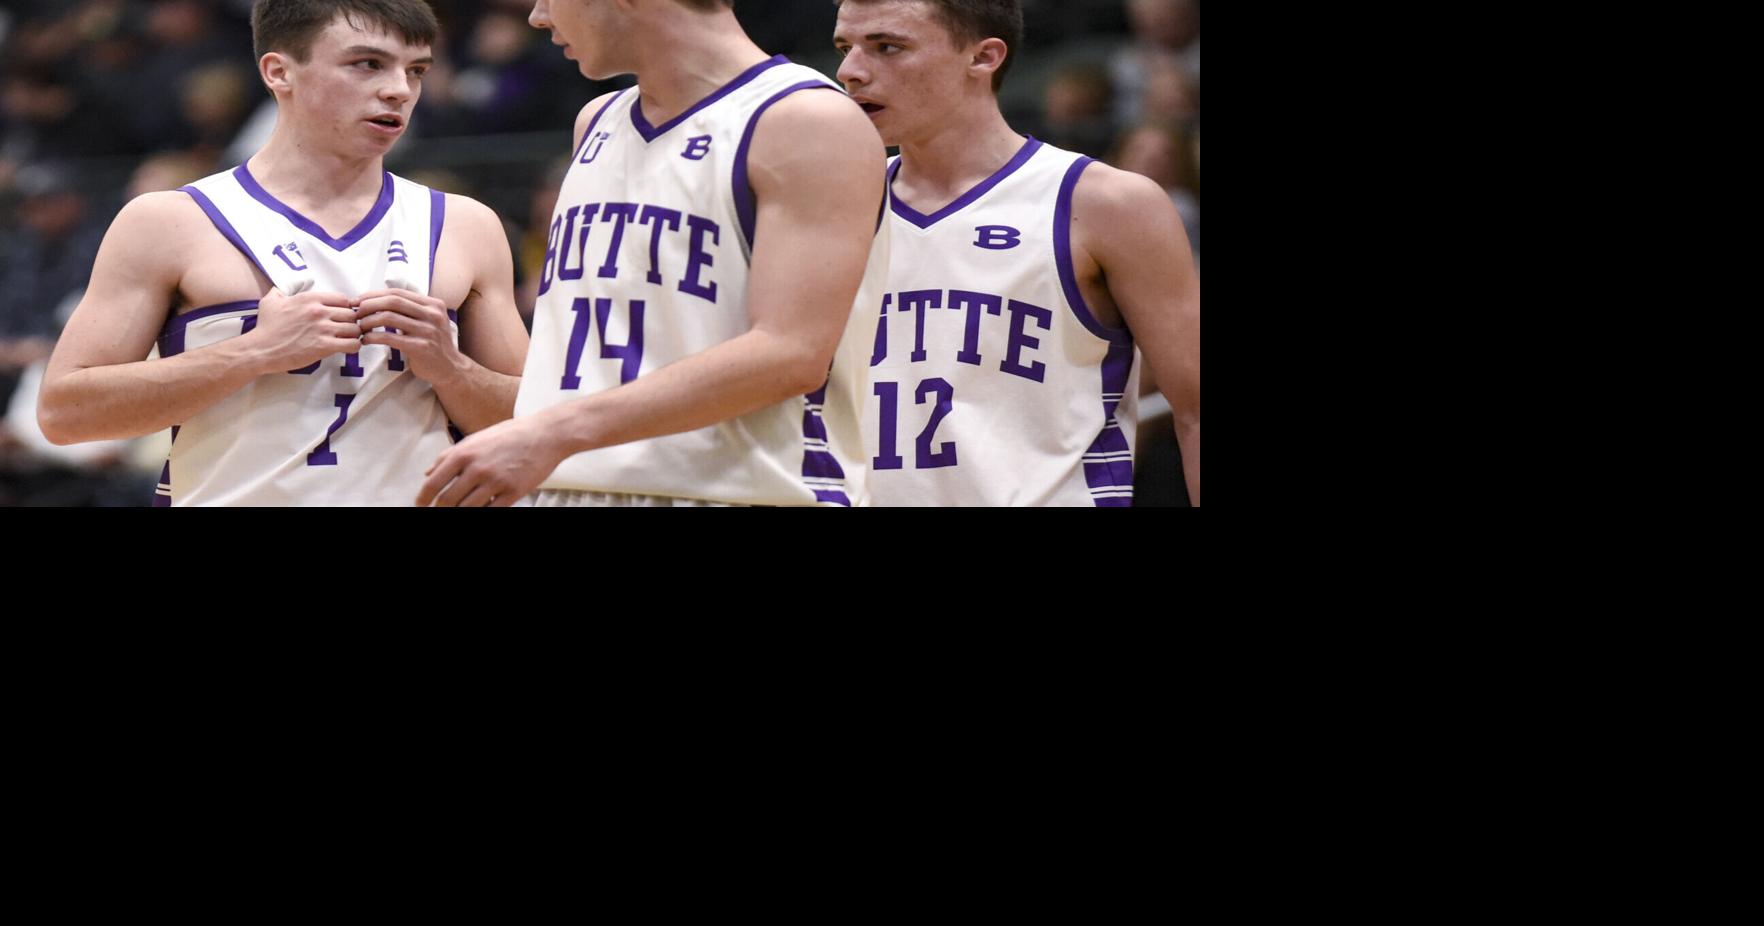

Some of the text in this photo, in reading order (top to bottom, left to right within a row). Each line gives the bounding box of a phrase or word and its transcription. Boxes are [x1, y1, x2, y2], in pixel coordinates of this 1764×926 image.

[680, 134, 712, 161] B
[537, 202, 720, 304] BUTTE
[973, 225, 1021, 250] B
[560, 297, 646, 390] 14
[873, 377, 958, 470] 12
